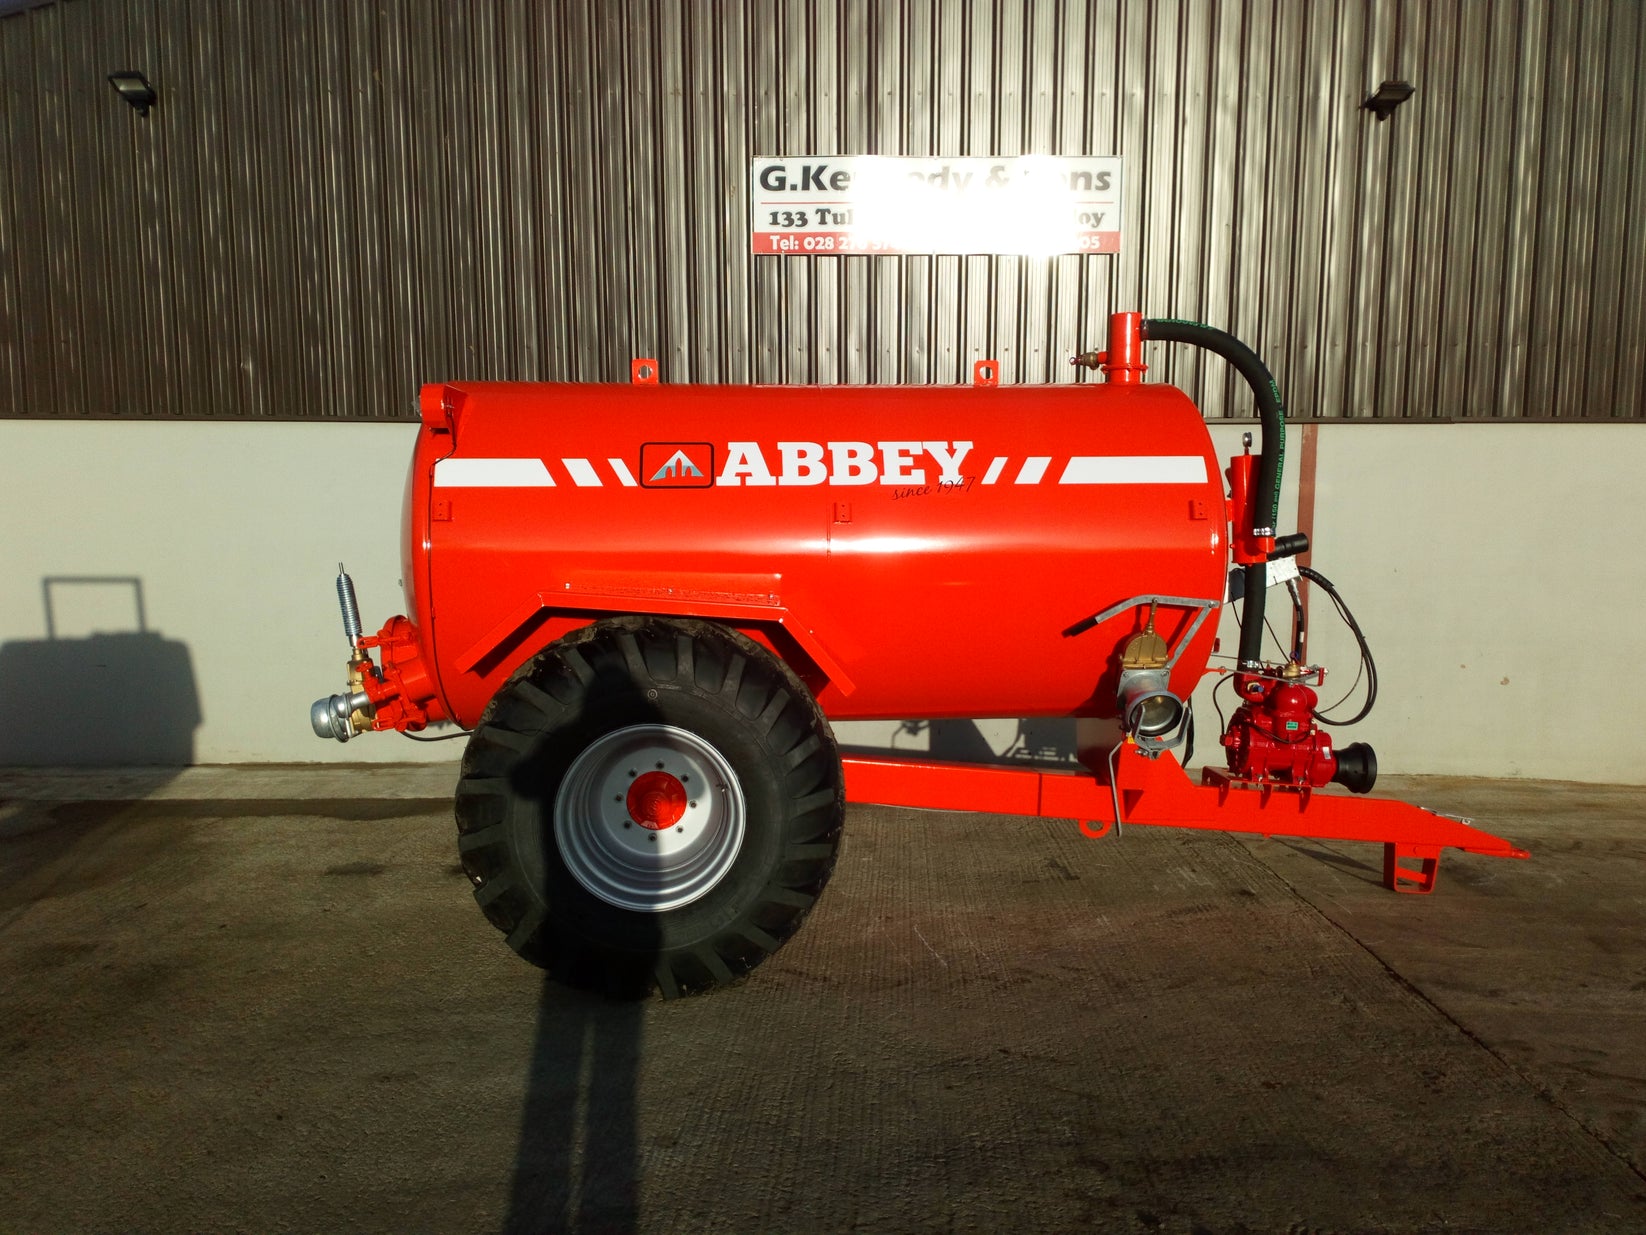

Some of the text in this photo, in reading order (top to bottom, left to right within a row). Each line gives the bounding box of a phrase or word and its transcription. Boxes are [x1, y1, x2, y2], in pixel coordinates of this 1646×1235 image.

[769, 211, 808, 228] 133
[770, 235, 799, 250] Tel:
[803, 236, 834, 250] 028
[1278, 410, 1286, 450] PURPOSE
[716, 441, 974, 486] ABBEY
[1274, 453, 1285, 490] GENERAL
[892, 476, 976, 500] since 1947
